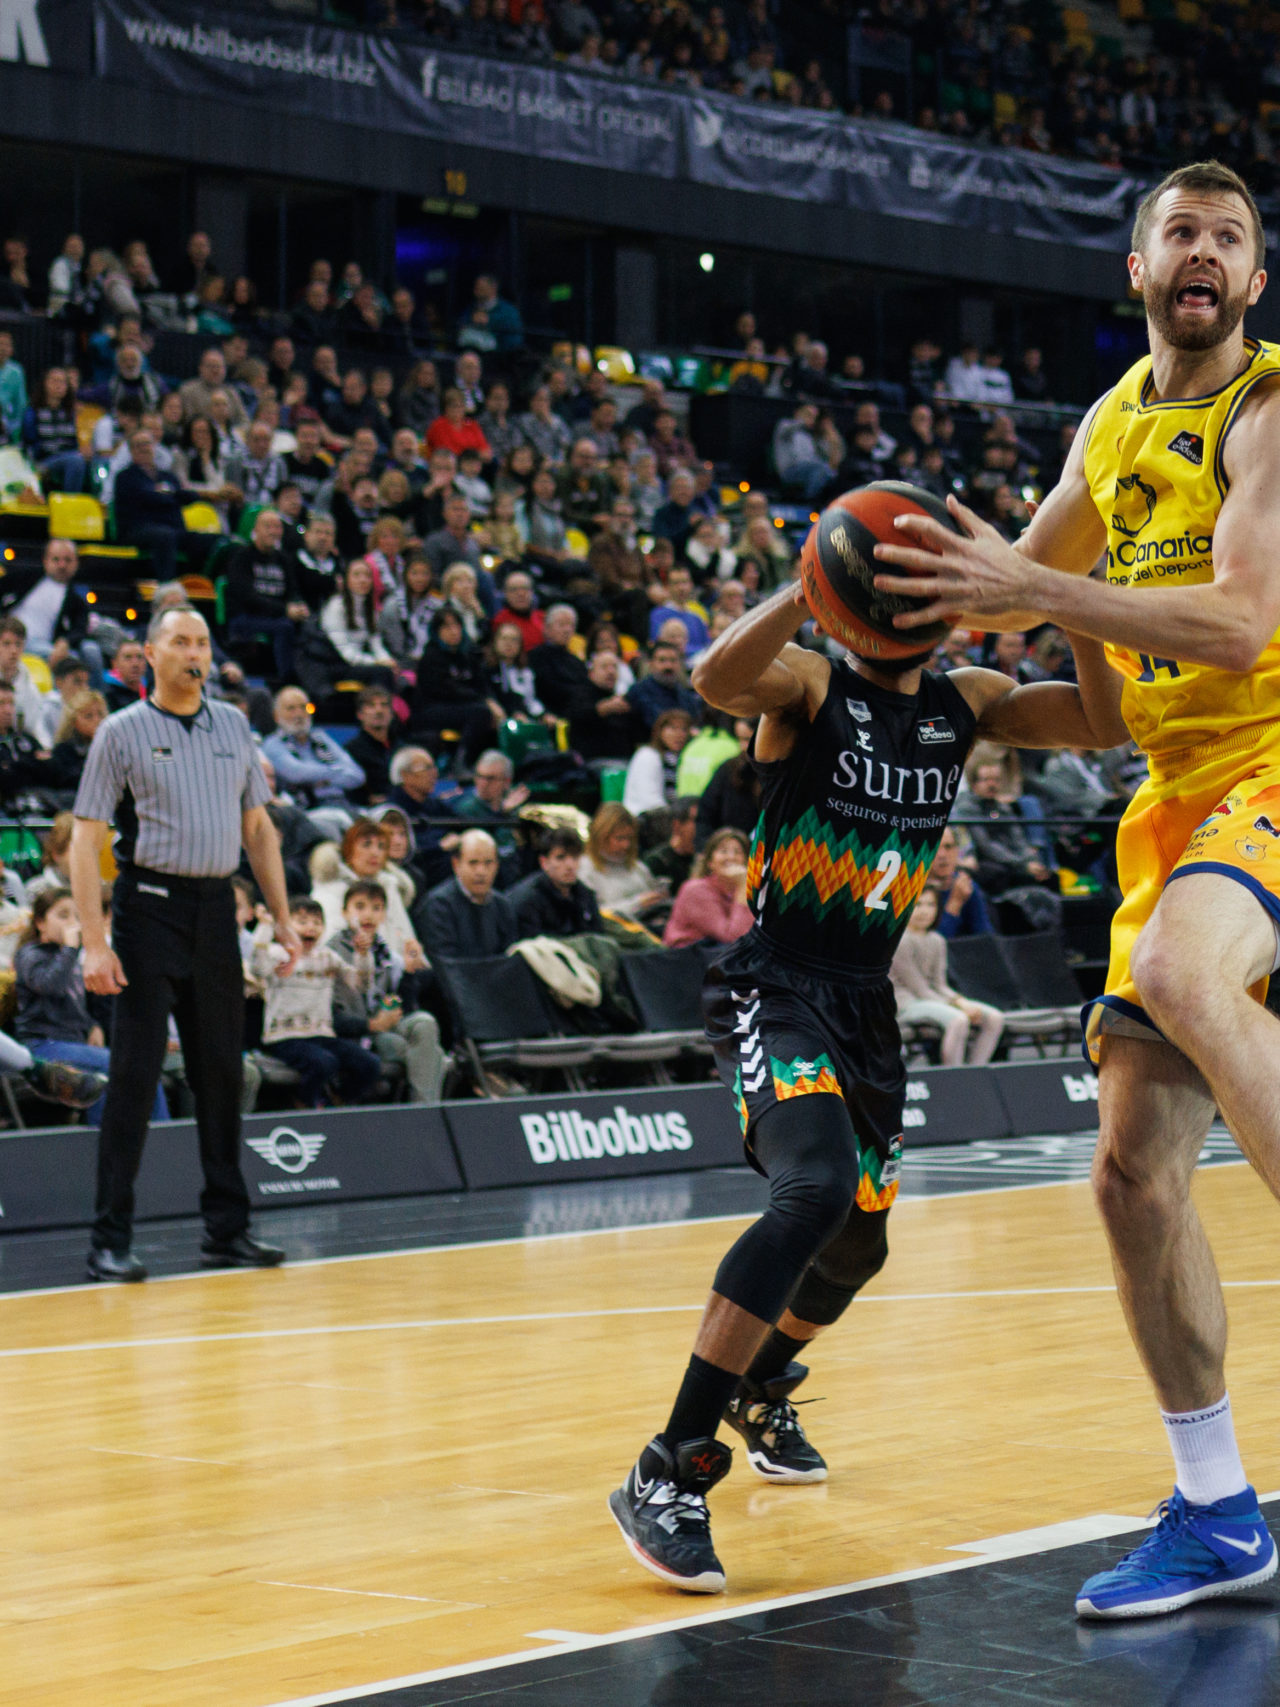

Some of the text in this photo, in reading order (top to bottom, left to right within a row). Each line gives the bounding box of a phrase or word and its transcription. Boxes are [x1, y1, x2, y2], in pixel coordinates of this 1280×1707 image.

[123, 17, 378, 88] www.bilbaobasket.biz
[516, 92, 594, 126] BASKET
[832, 750, 960, 804] surne
[826, 796, 888, 824] seguros
[890, 815, 900, 827] &
[863, 850, 902, 911] 2
[1062, 1072, 1099, 1102] bb
[519, 1105, 694, 1164] Bilbobus
